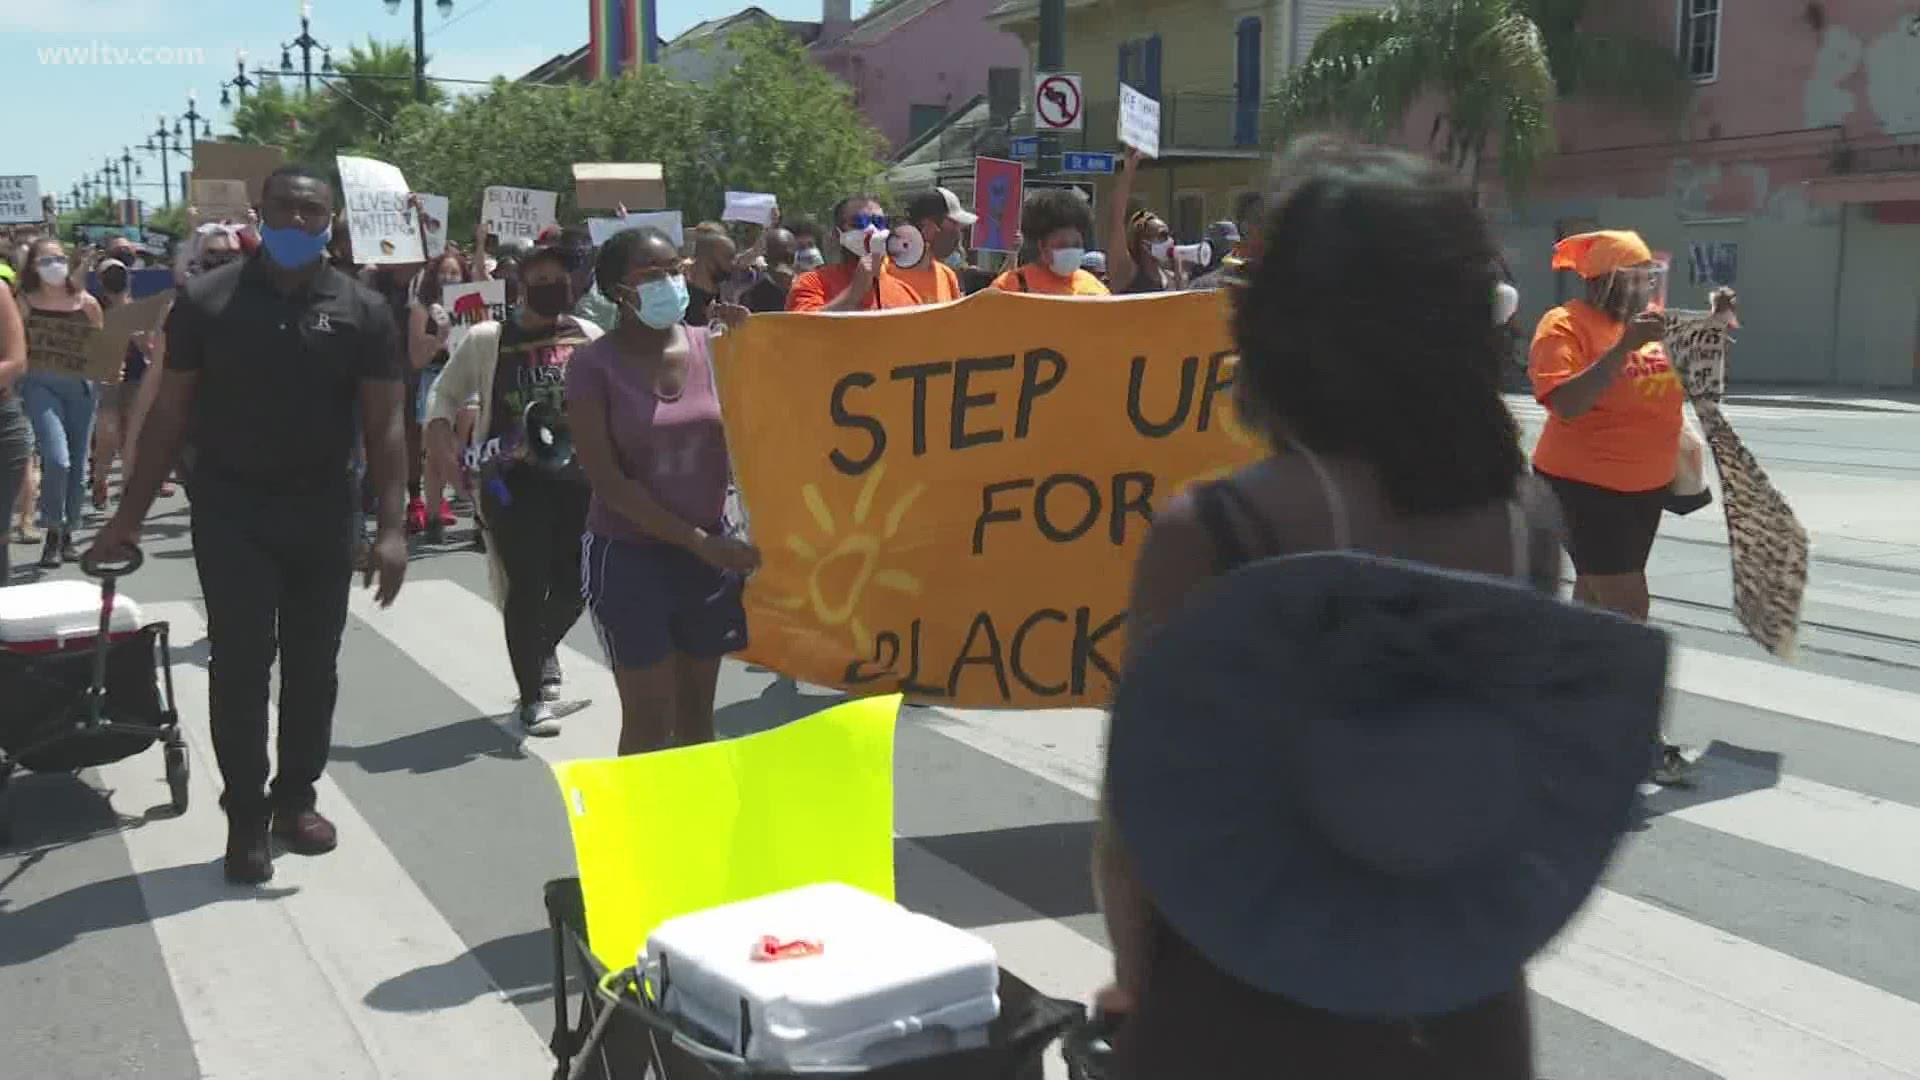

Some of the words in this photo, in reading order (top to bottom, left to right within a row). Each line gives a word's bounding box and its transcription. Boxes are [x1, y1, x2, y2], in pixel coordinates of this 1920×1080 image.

[349, 190, 405, 212] LIVES
[500, 206, 538, 221] LIVES
[829, 347, 1067, 476] STEP
[1127, 349, 1240, 439] UP
[972, 471, 1156, 556] FOR
[844, 606, 1123, 703] BLACK
